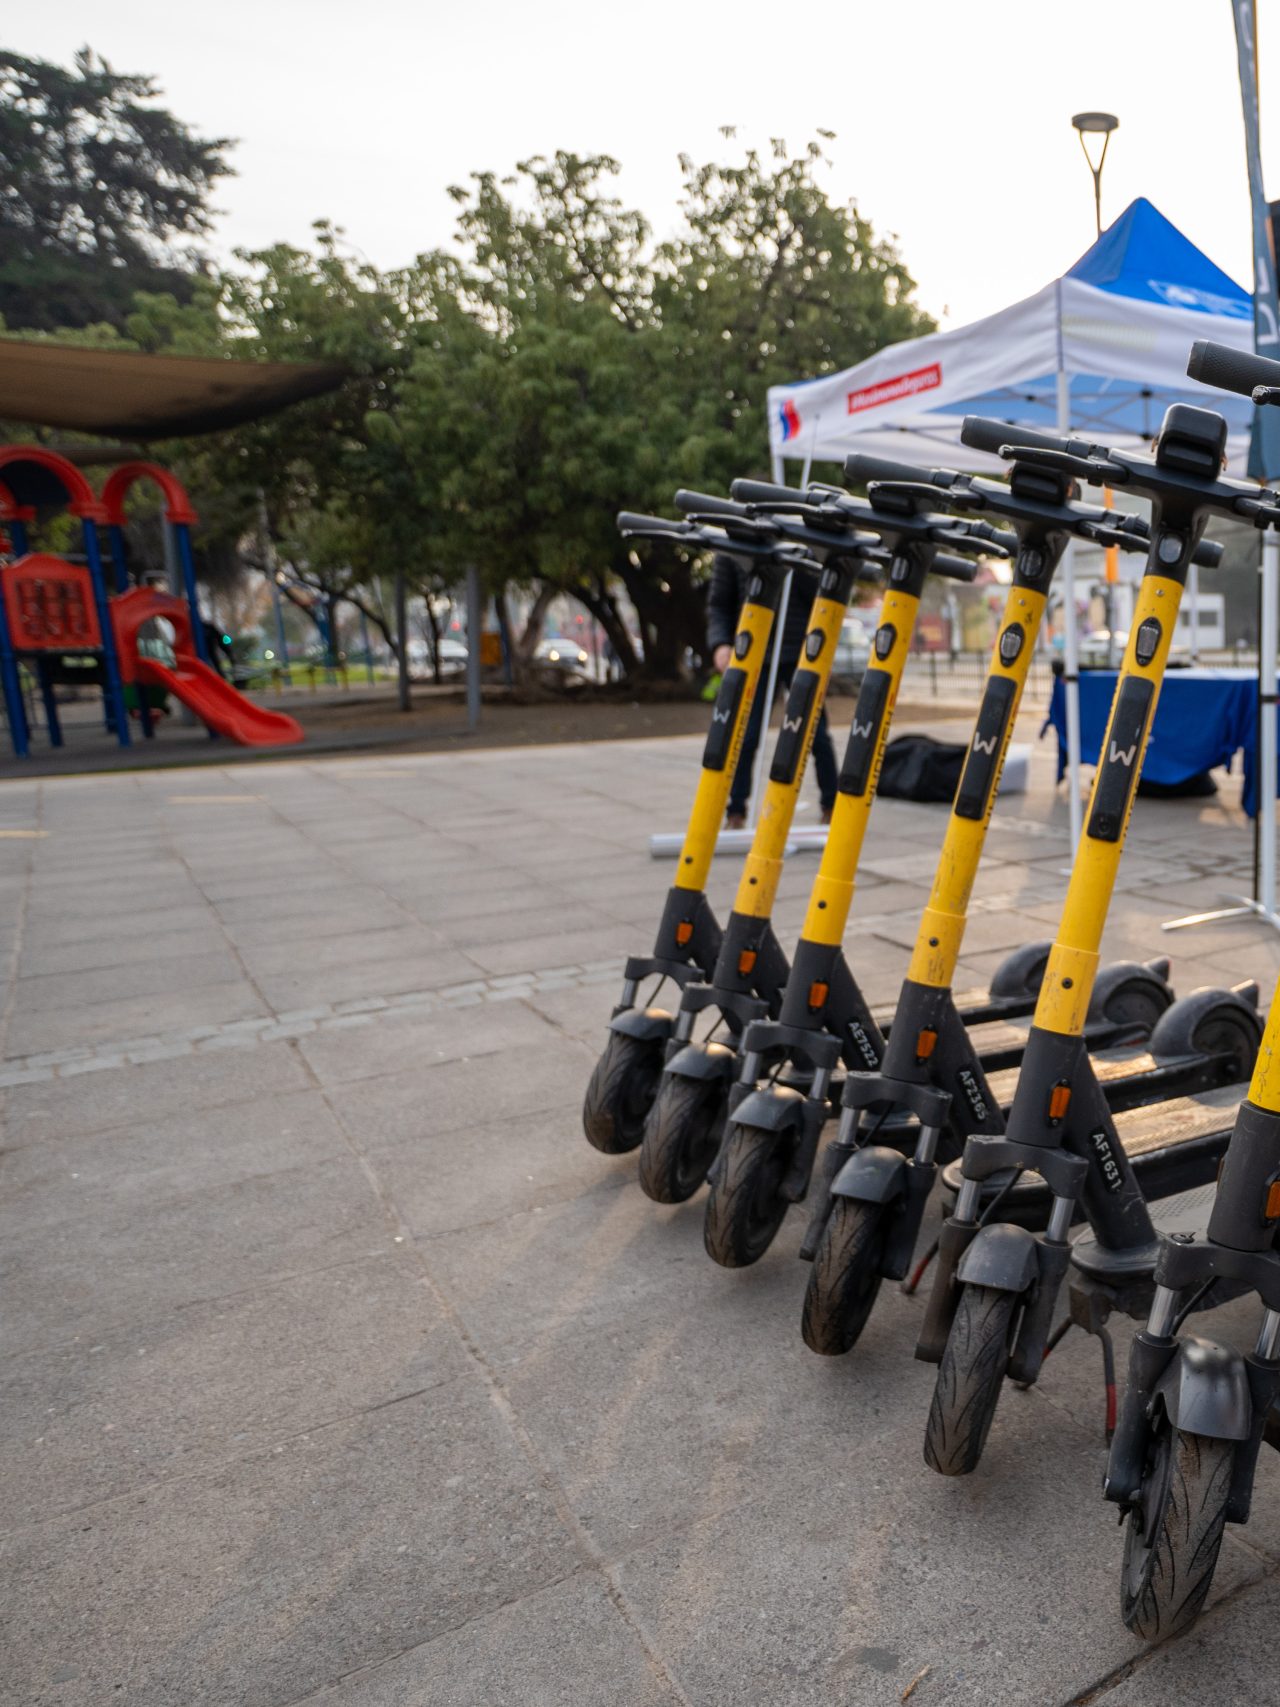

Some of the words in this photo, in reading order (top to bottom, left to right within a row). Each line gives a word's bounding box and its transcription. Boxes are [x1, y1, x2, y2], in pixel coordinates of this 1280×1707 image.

[972, 731, 998, 756] W
[1109, 740, 1136, 767] W
[1092, 1132, 1121, 1190] AF1631
